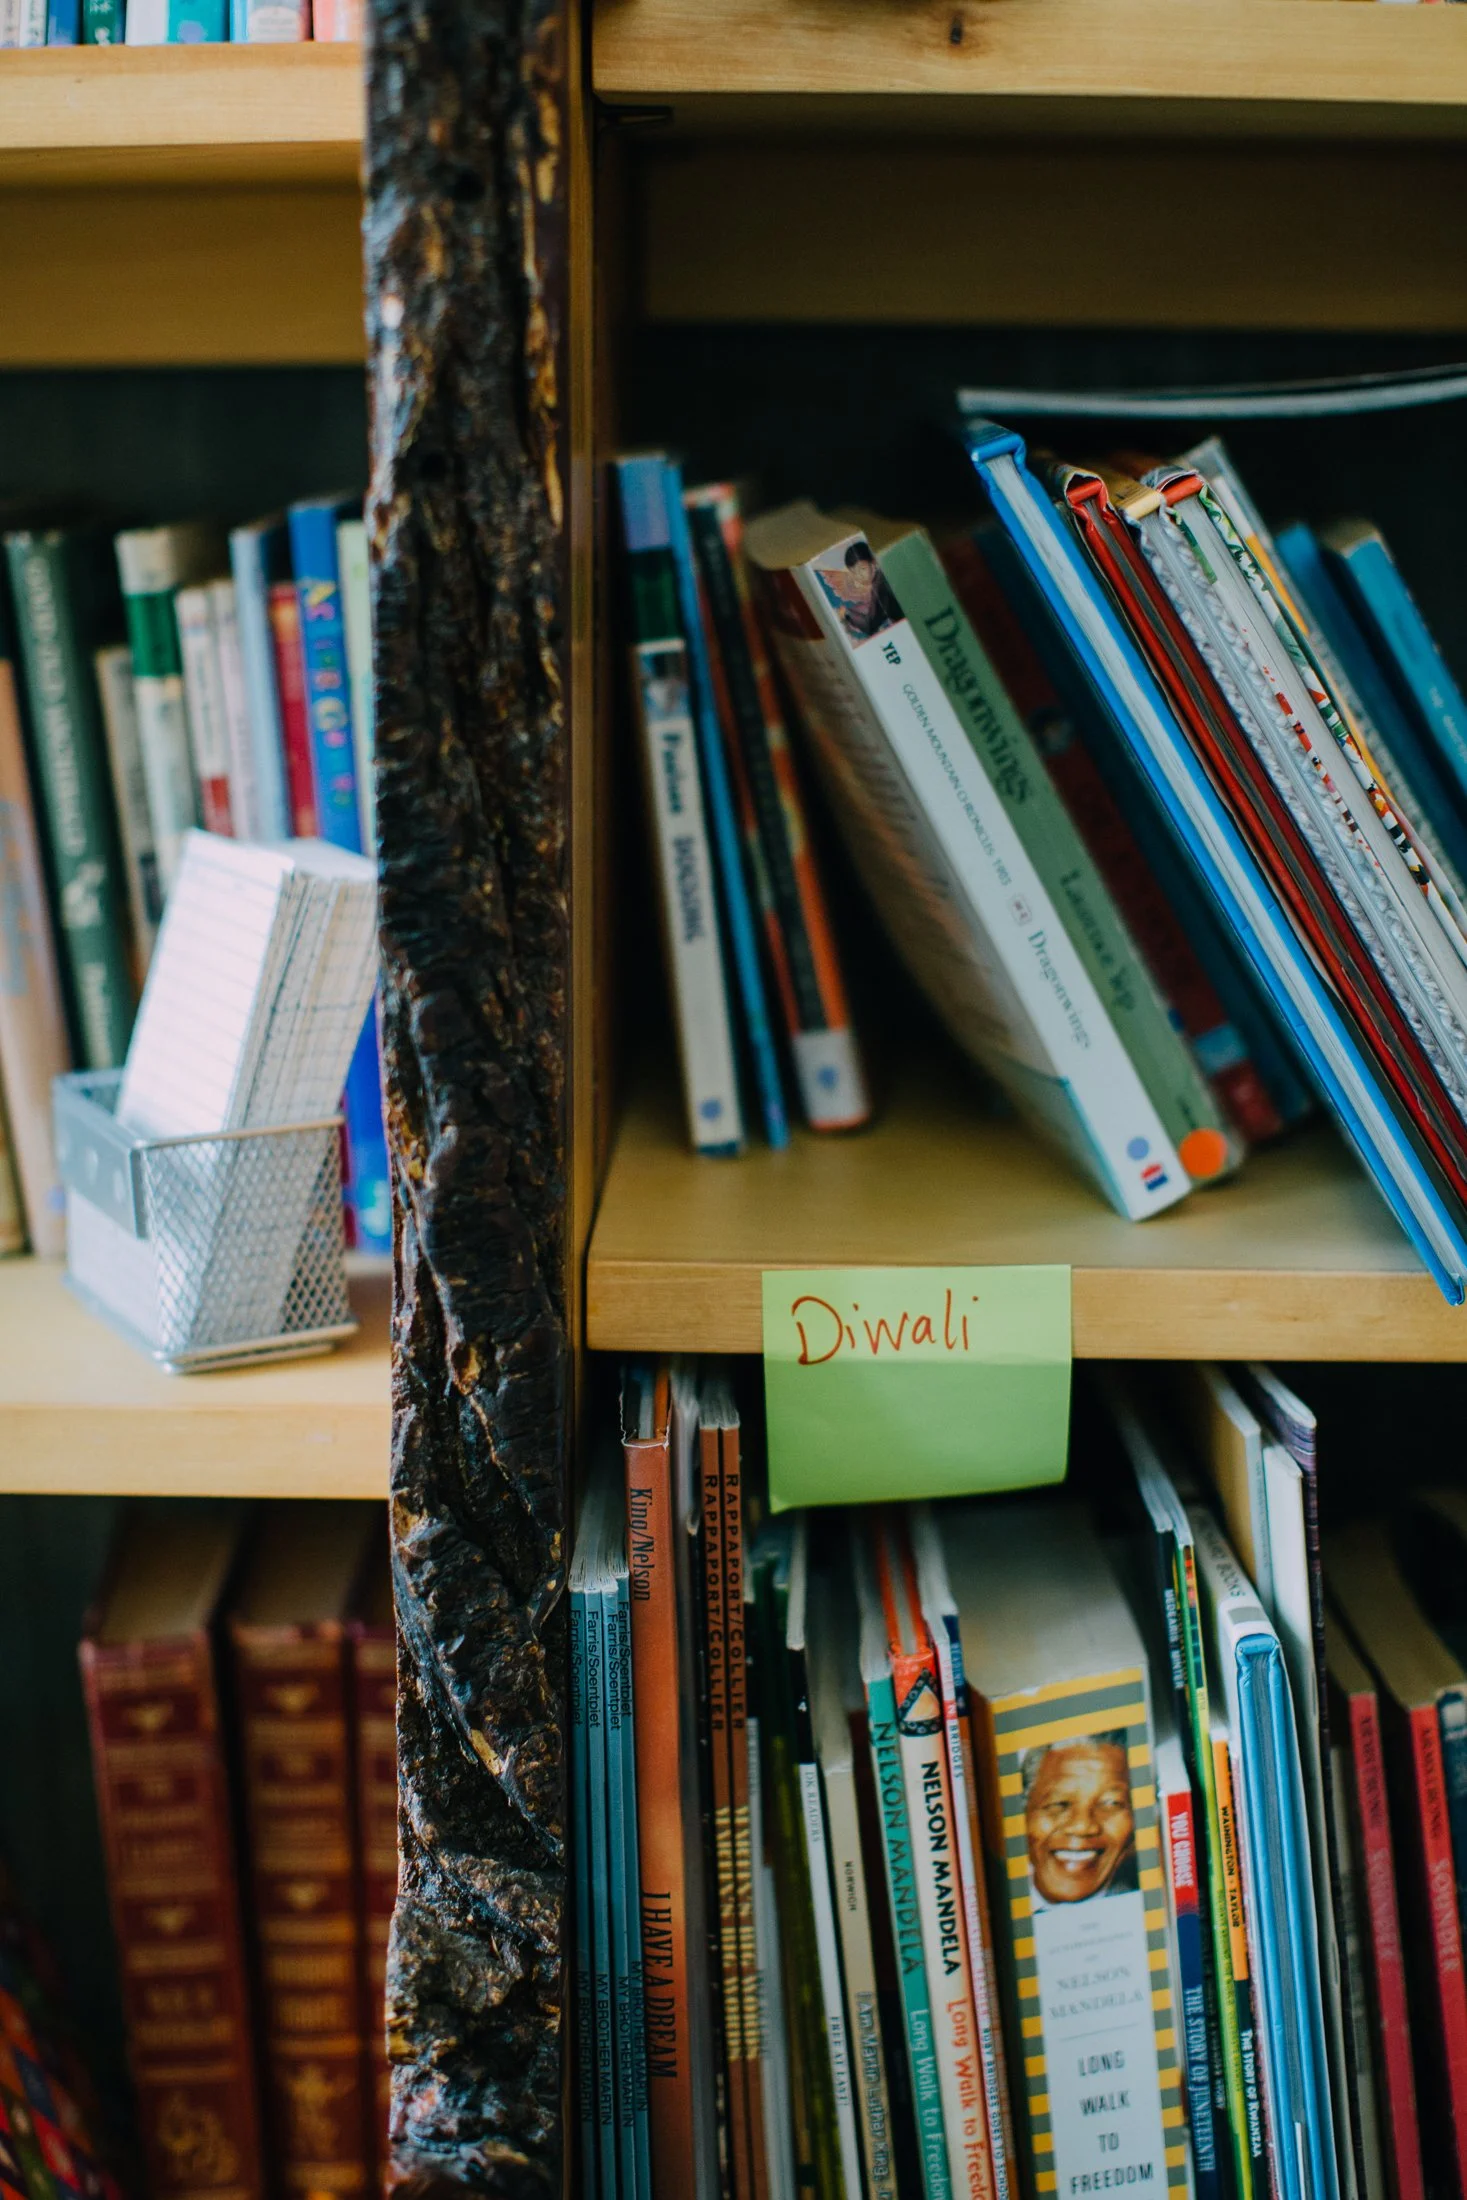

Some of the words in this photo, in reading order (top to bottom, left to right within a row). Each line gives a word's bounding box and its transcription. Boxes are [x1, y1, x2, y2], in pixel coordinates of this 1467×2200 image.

[924, 604, 1033, 805] Dragonwings
[881, 640, 902, 666] YEP
[924, 727, 961, 790] MOUNTAIN
[1027, 928, 1093, 1051] Dragonwings
[791, 1288, 979, 1366] Diwali
[629, 1487, 655, 1601] King/Nelson
[704, 1474, 723, 1731] RAPPAPORT/COLLIER
[725, 1473, 744, 1730] RAPPAPORT/COLLIER
[570, 1609, 583, 1727] Farris/Soentpiet
[587, 1610, 600, 1728] Farris/Soentpiet
[607, 1613, 621, 1731] Farris/Soentpiet
[618, 1601, 632, 1717] Farris/Soentpiet
[874, 1721, 905, 1830] NELSON
[948, 1725, 962, 1779] BRIDGES
[804, 1772, 816, 1789] DK
[921, 1760, 949, 1853] NELSON
[806, 1792, 821, 1843] READERS
[1170, 1811, 1189, 1839] YOU
[843, 1860, 857, 1912] NORWICH
[1172, 1840, 1193, 1888] CHOOSE
[641, 1891, 671, 1900] I
[889, 1838, 921, 1977] MANDELA
[932, 1860, 961, 1977] MANDELA
[1229, 1888, 1240, 1928] TAYLOR
[1429, 1857, 1459, 1973] SOUNDER
[643, 1907, 674, 1969] HAVE
[577, 1970, 589, 1992] MY
[596, 1974, 608, 1996] MY
[618, 1976, 629, 1999] MY
[630, 1961, 642, 1982] MY
[645, 1974, 675, 1988] A
[632, 1987, 644, 2055] BROTHER
[946, 1997, 971, 2048] Long
[1184, 1985, 1204, 2015] THE
[579, 1997, 591, 2065] BROTHER
[598, 2000, 610, 2068] BROTHER
[619, 2002, 631, 2070] BROTHER
[645, 1996, 678, 2079] DREAM
[910, 2008, 931, 2052] Long
[1186, 2017, 1208, 2062] STORY
[1240, 2029, 1253, 2051] THE
[861, 2034, 880, 2081] Martin
[916, 2057, 937, 2101] Walk
[953, 2055, 977, 2110] Walk
[1077, 2050, 1126, 2078] LONG
[1190, 2064, 1211, 2083] OF
[1242, 2053, 1255, 2084] STORY
[581, 2069, 593, 2123] MARTIN
[600, 2072, 612, 2125] MARTIN
[621, 2074, 633, 2128] MARTIN
[636, 2059, 648, 2112] MARTIN
[1079, 2090, 1131, 2117] WALK
[1246, 2087, 1257, 2099] OF
[867, 2087, 888, 2138] Luther
[922, 2108, 939, 2127] to
[962, 2118, 980, 2136] to
[1188, 2084, 1216, 2171] JUNETEENTH
[1248, 2102, 1261, 2158] KWANZAA
[1097, 2132, 1120, 2154] TO
[1070, 2161, 1154, 2196] FREEDOM
